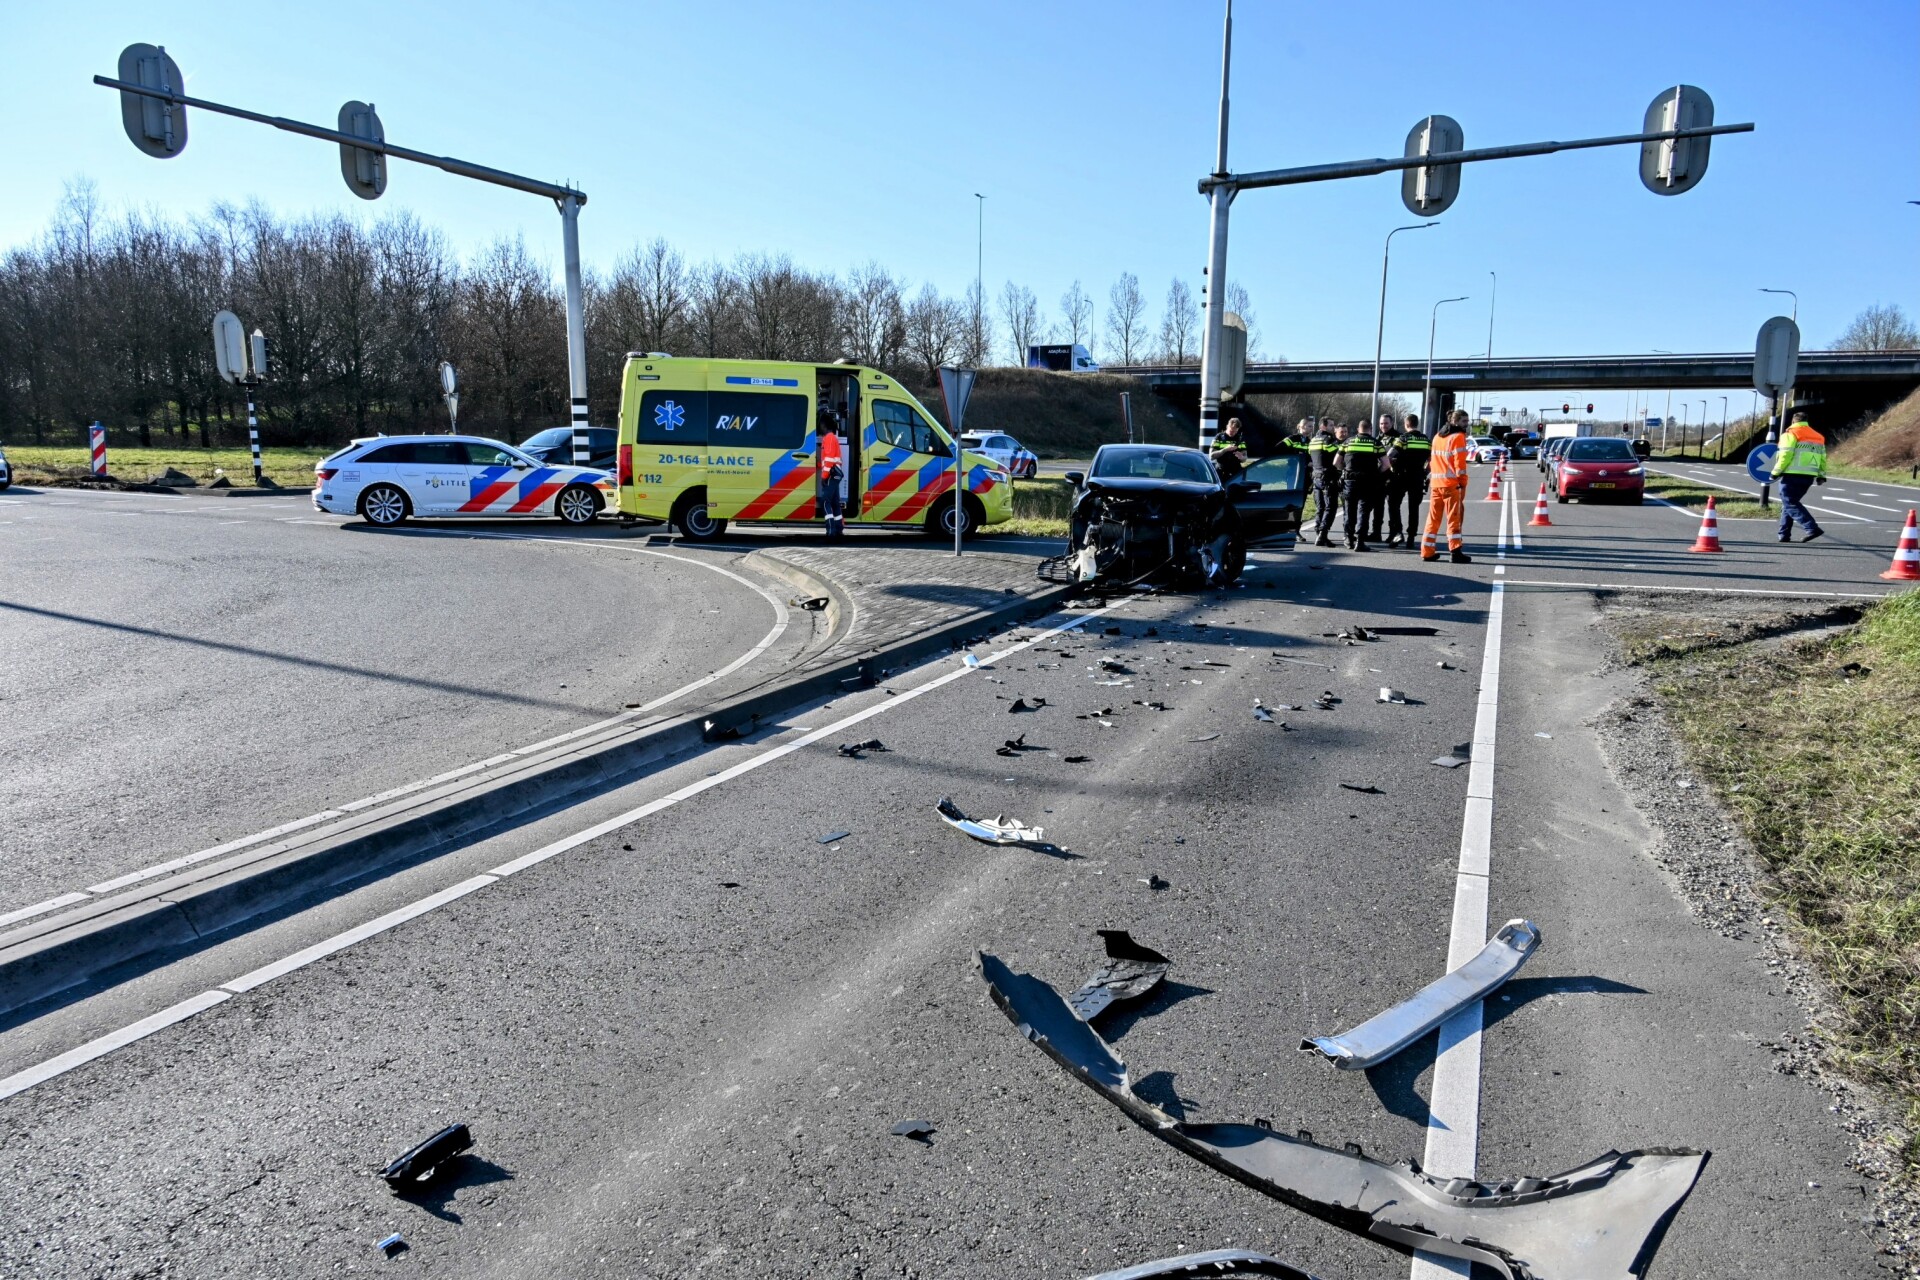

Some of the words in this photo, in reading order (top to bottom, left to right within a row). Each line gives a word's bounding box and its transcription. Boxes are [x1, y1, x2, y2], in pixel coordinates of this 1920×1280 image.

[752, 378, 772, 386] 20-164
[658, 453, 700, 465] 20-164
[708, 456, 754, 466] LANCE
[425, 477, 467, 488] POLITIE
